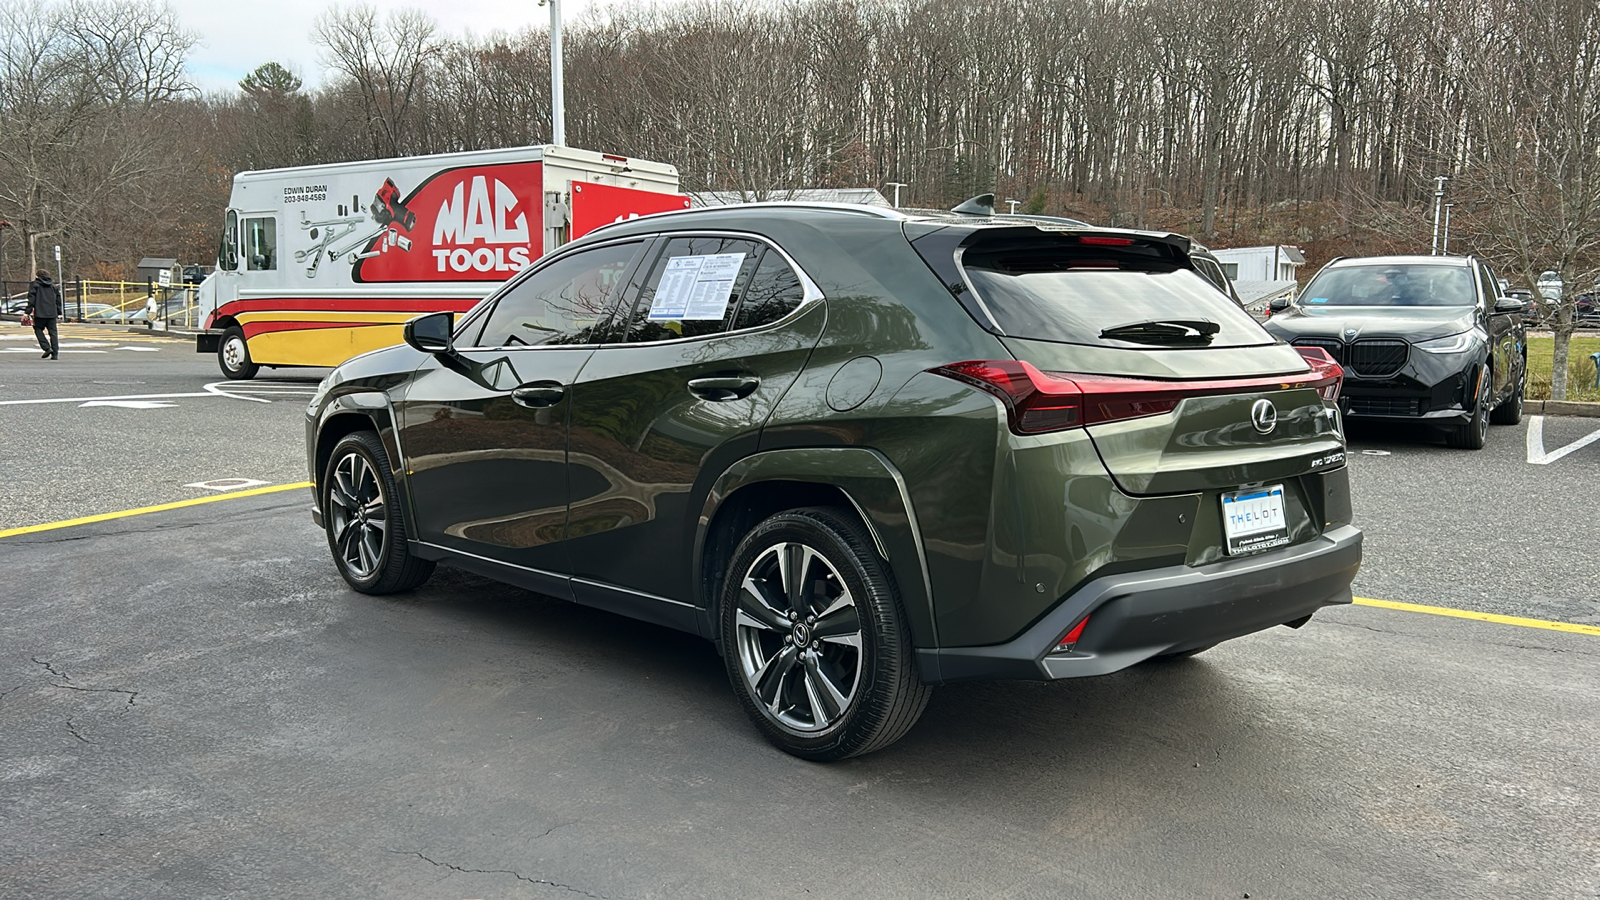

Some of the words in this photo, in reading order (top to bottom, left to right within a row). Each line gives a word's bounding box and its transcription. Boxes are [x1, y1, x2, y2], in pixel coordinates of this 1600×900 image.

[284, 187, 304, 195] EDWIN
[305, 185, 328, 194] DURAN
[284, 194, 326, 203] 203-948-4569
[432, 175, 530, 246] MAC
[432, 246, 531, 273] TOOLS
